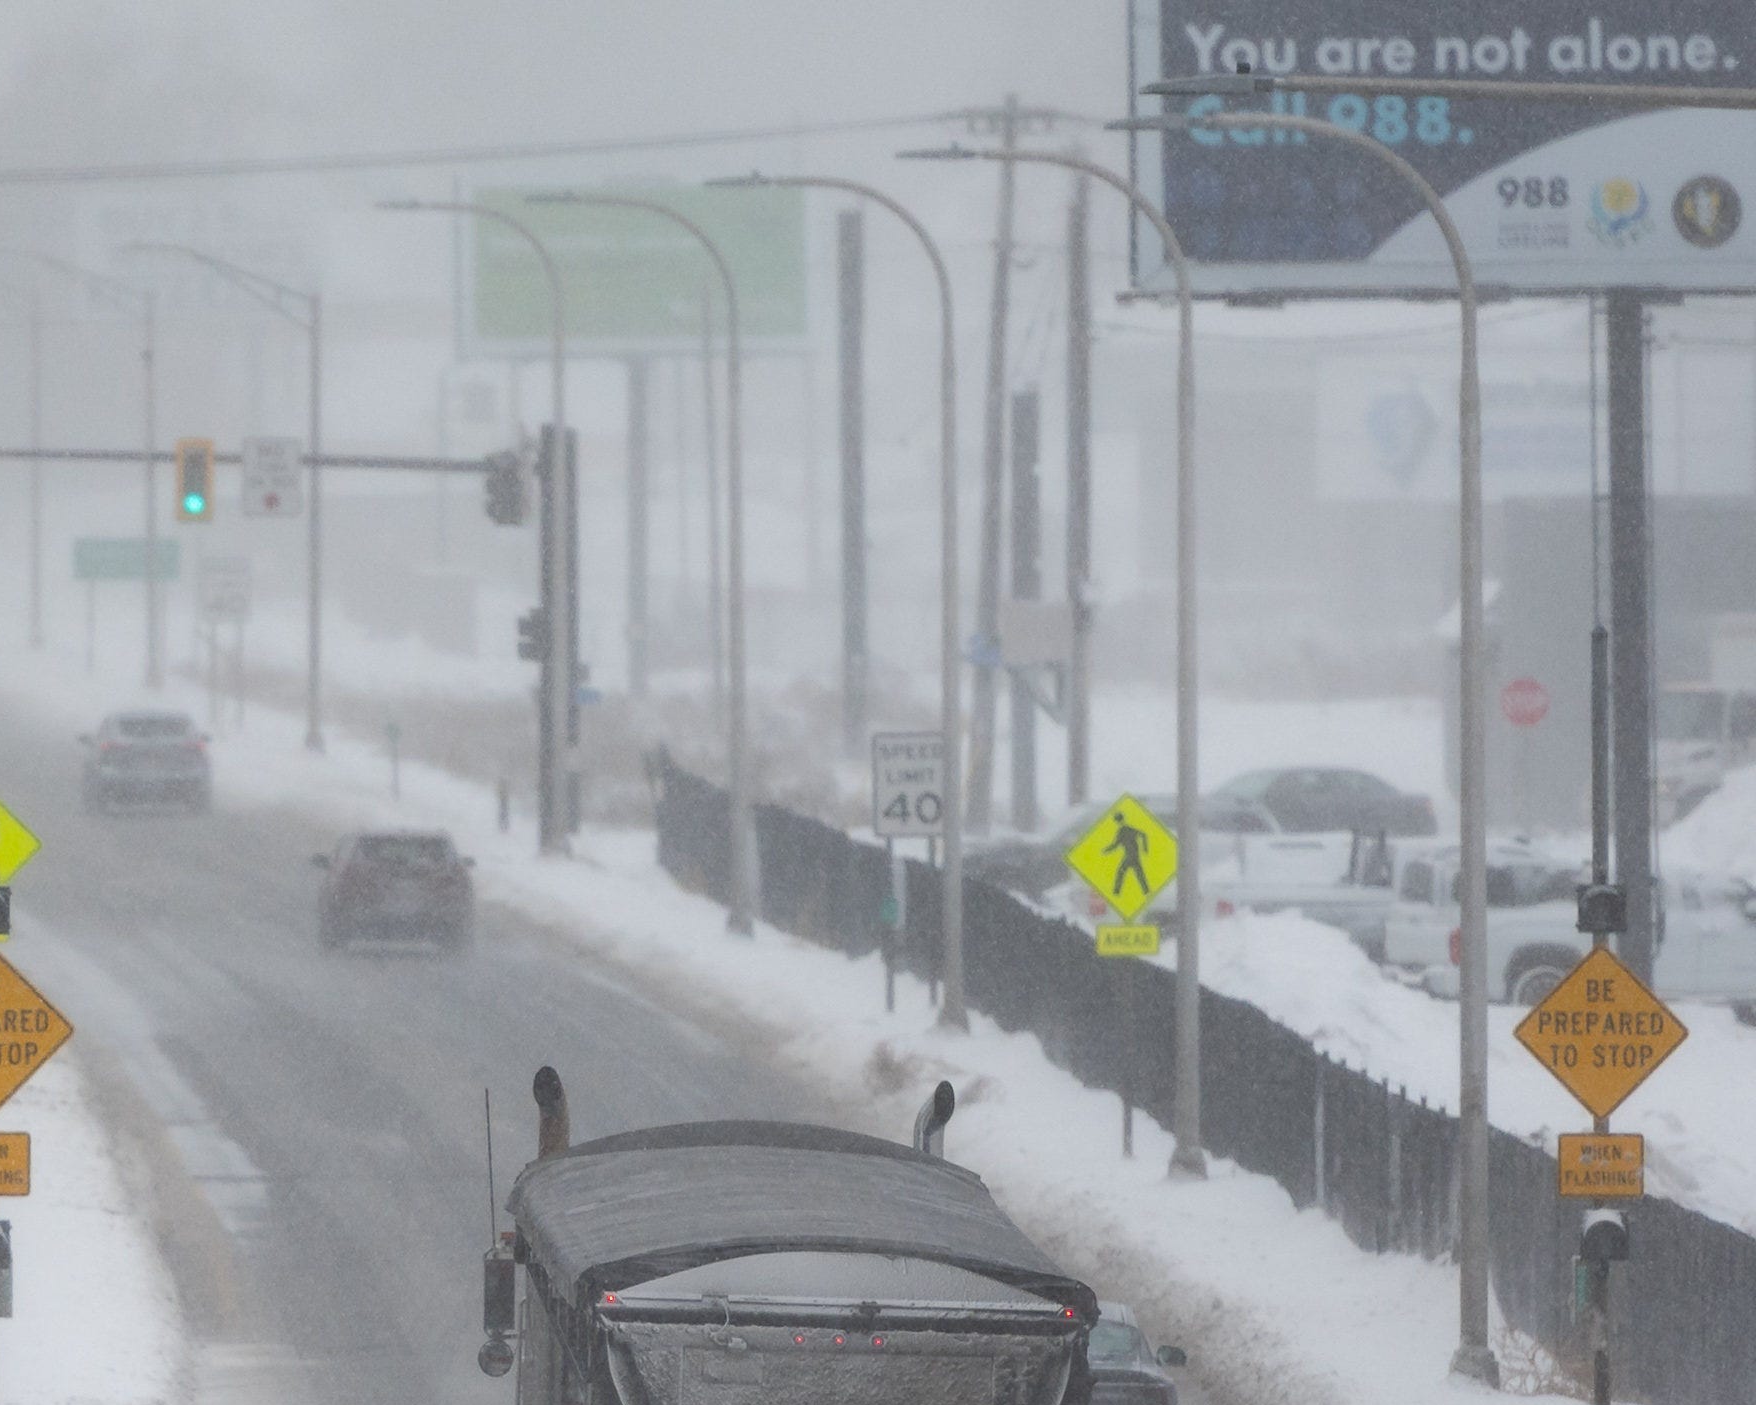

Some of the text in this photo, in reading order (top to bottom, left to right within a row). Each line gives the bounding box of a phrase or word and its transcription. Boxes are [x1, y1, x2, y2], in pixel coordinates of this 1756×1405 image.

[1185, 18, 1740, 73] You are not alone.
[1328, 93, 1475, 146] 988.
[1497, 177, 1569, 208] 988
[884, 767, 935, 784] LIMIT
[882, 791, 943, 825] 40
[1103, 932, 1153, 947] AHEAD
[1585, 979, 1616, 1003] BE
[1538, 1011, 1664, 1036] PREPARED
[1550, 1044, 1654, 1068] TO STOP
[1580, 1144, 1622, 1160] WHEN
[1564, 1169, 1637, 1186] FLASHING
